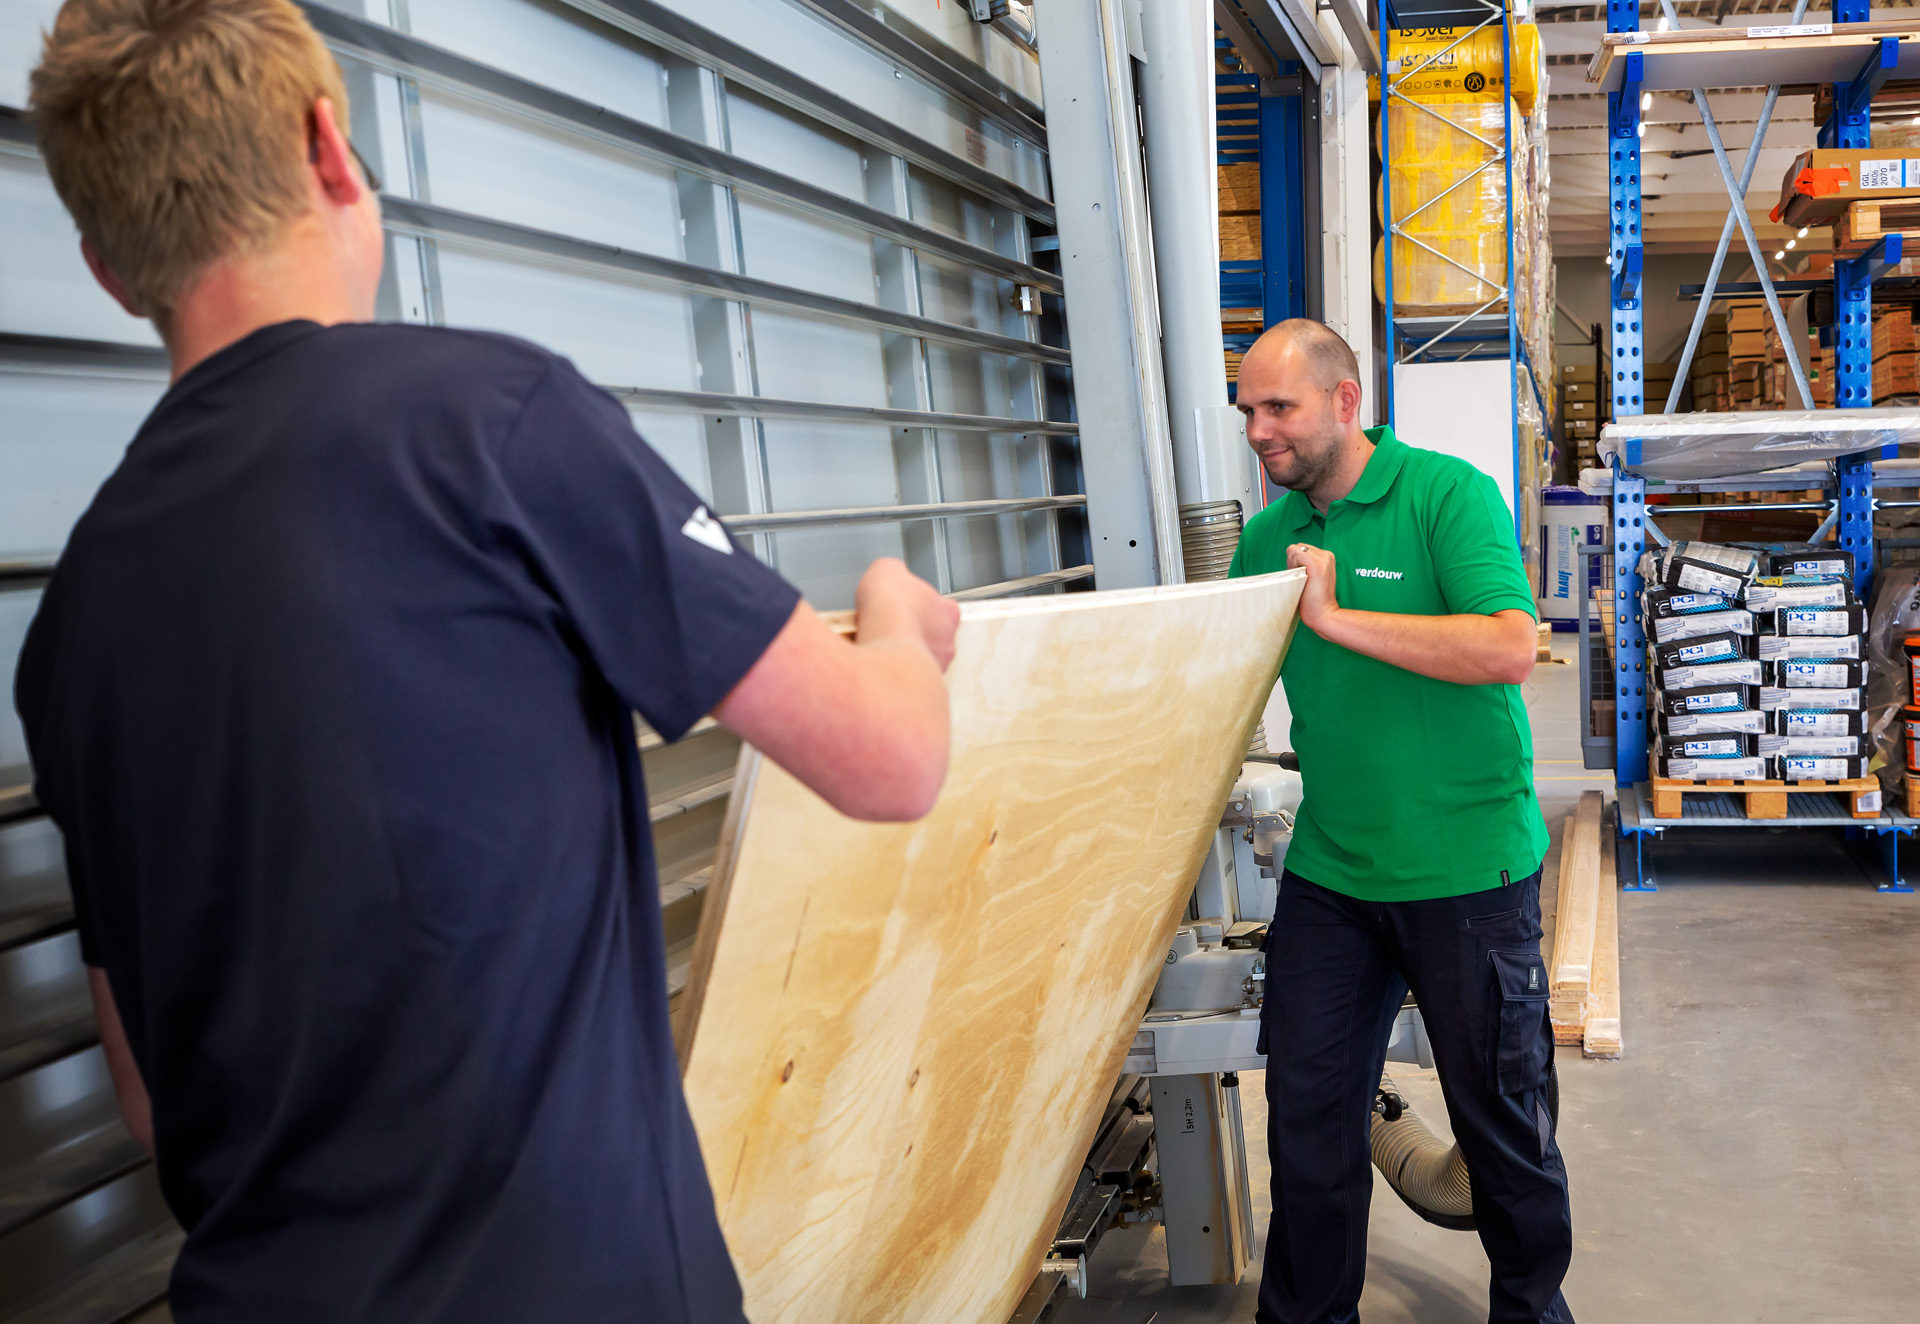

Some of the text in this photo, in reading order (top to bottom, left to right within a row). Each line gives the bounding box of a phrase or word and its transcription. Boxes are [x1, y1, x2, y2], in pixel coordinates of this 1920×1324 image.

[1862, 173, 1870, 187] GGL
[1880, 167, 1888, 186] 2070
[1795, 562, 1818, 570] PCI
[1671, 595, 1695, 605] PCI
[1788, 613, 1816, 622] PCI
[1680, 646, 1704, 657] PCI
[1788, 665, 1815, 674] PCI
[1687, 696, 1710, 705] PCI
[1789, 715, 1816, 724] PCI
[1685, 743, 1709, 751] PCI
[1788, 760, 1816, 769] PCI
[1186, 1118, 1195, 1130] SH
